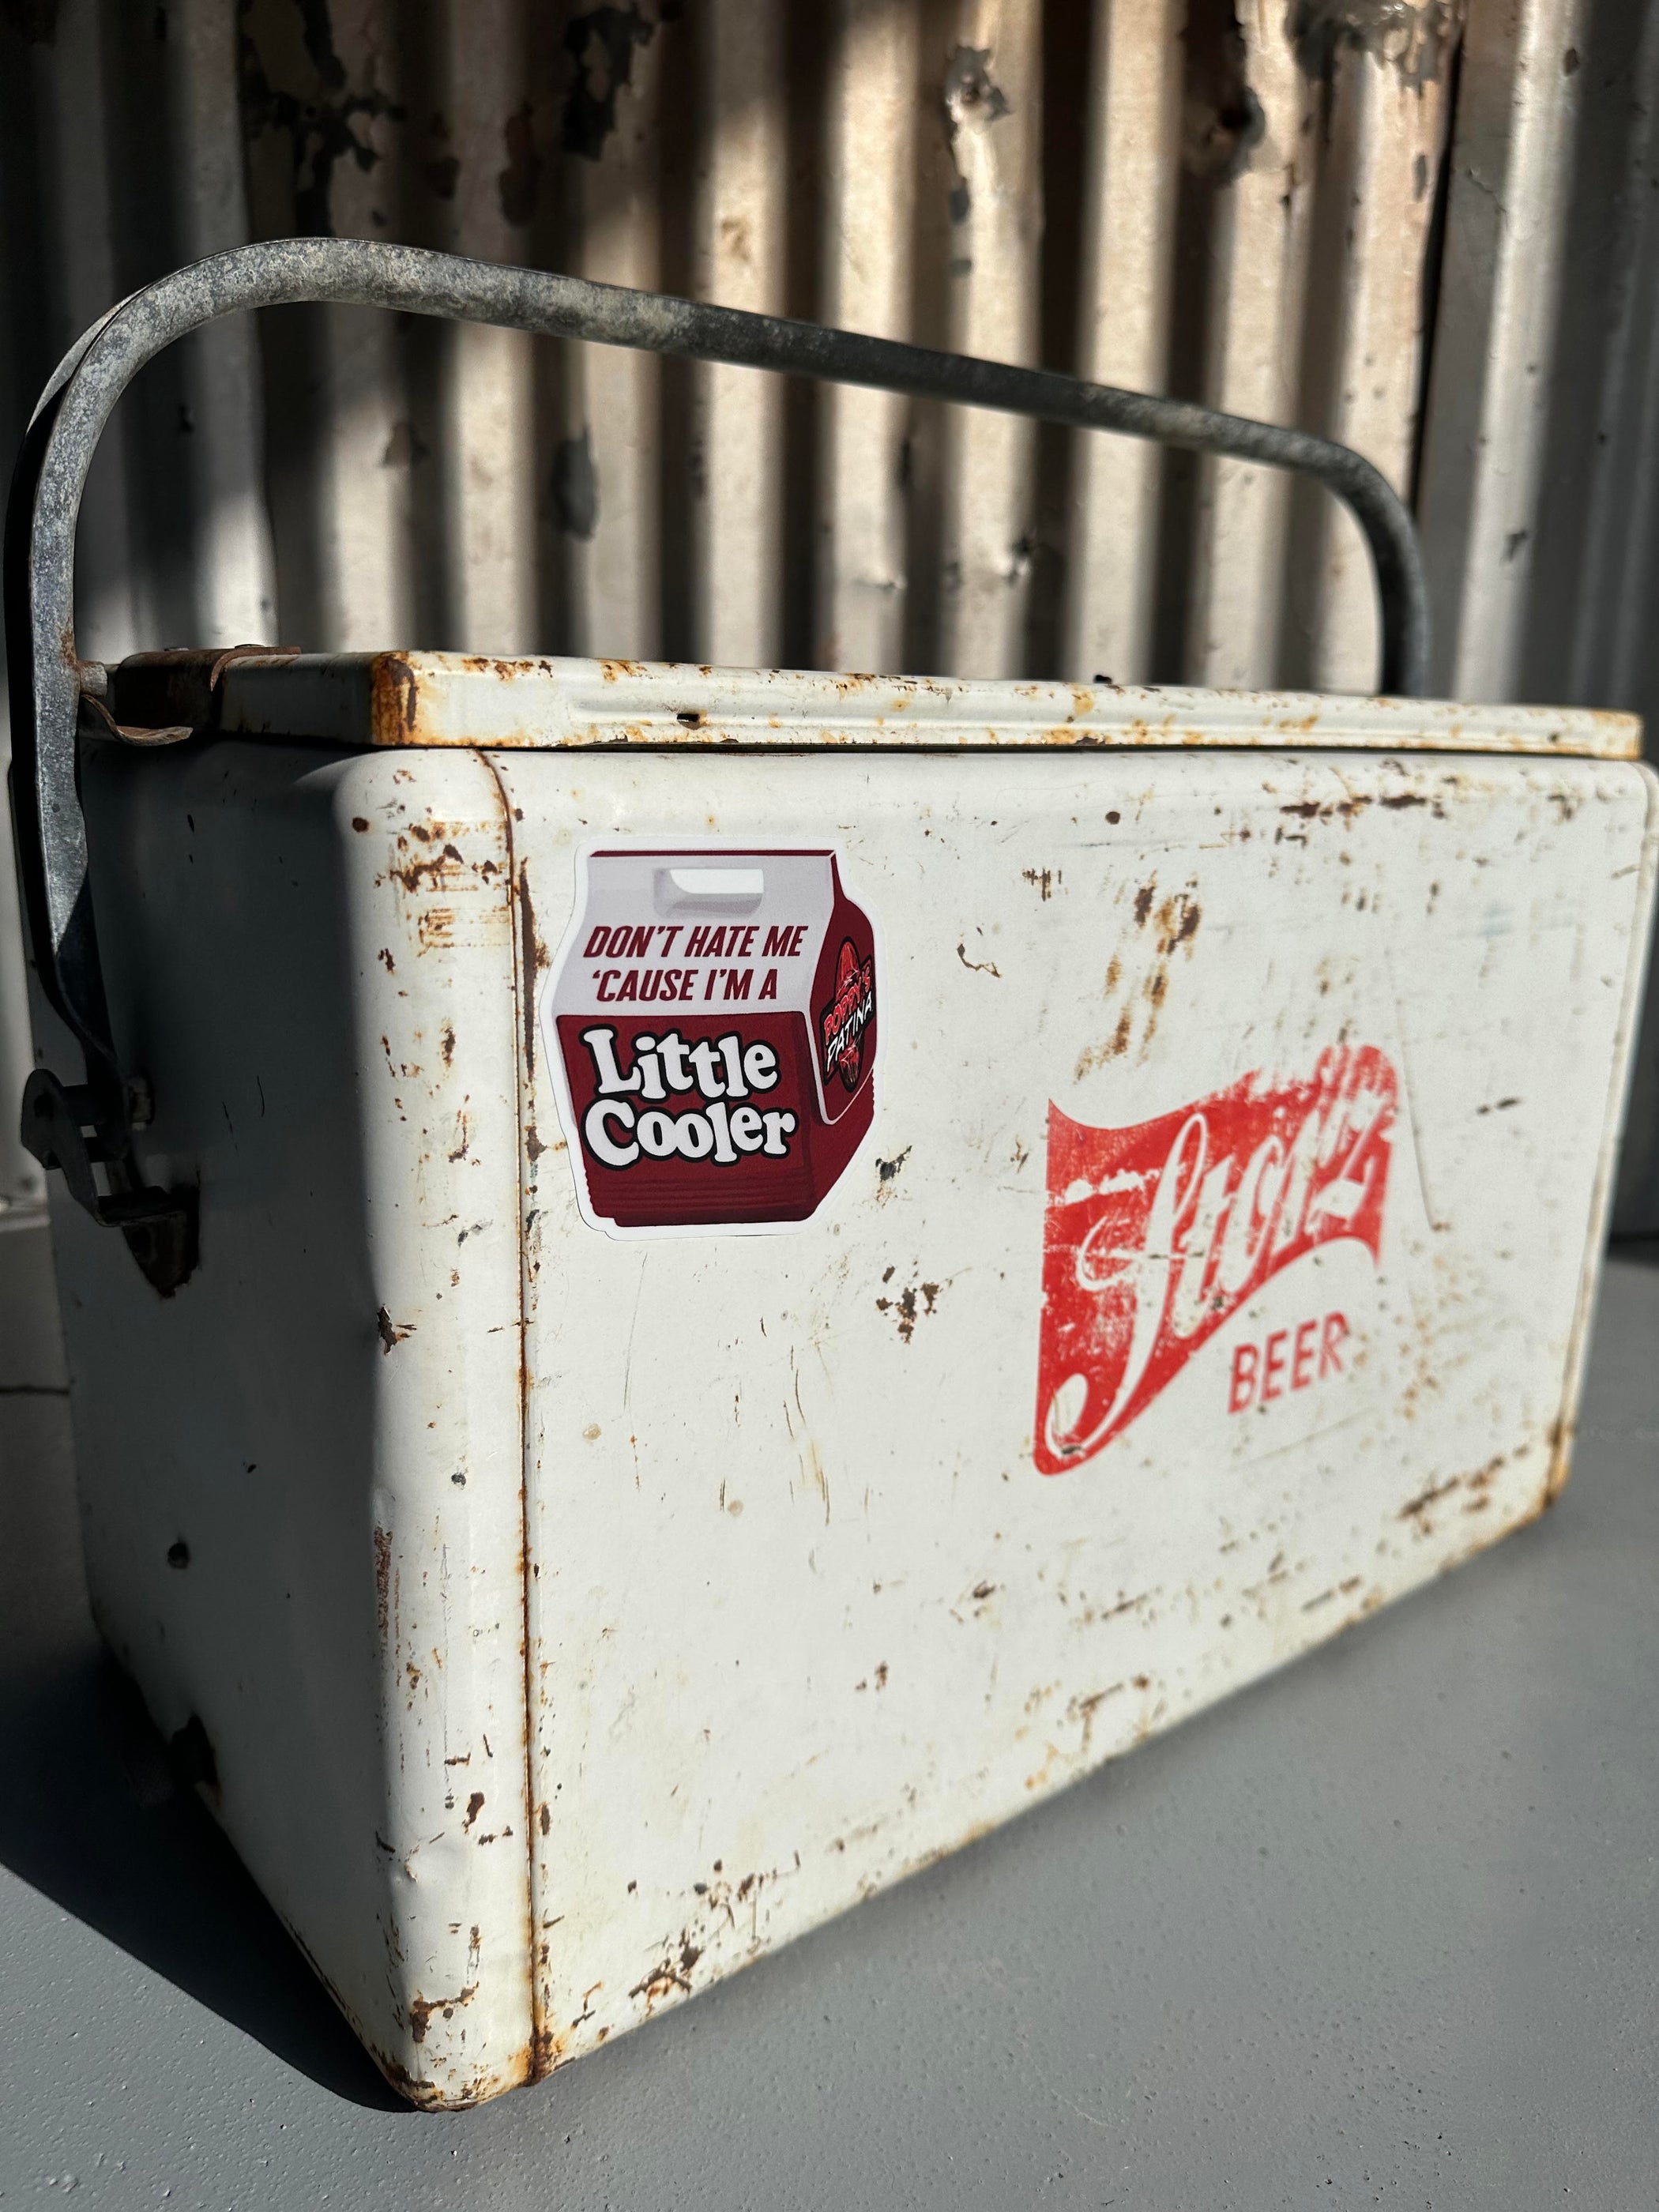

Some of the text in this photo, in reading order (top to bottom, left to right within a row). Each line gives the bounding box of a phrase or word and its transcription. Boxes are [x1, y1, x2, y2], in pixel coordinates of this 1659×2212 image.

[583, 925, 808, 957] DON'T HATE ME
[704, 969, 754, 1000] I'M
[759, 969, 779, 1000] A
[583, 1029, 779, 1099] Little
[826, 990, 872, 1073] PATINA
[585, 1099, 796, 1167] Cooler
[1228, 1312, 1350, 1413] BEER
